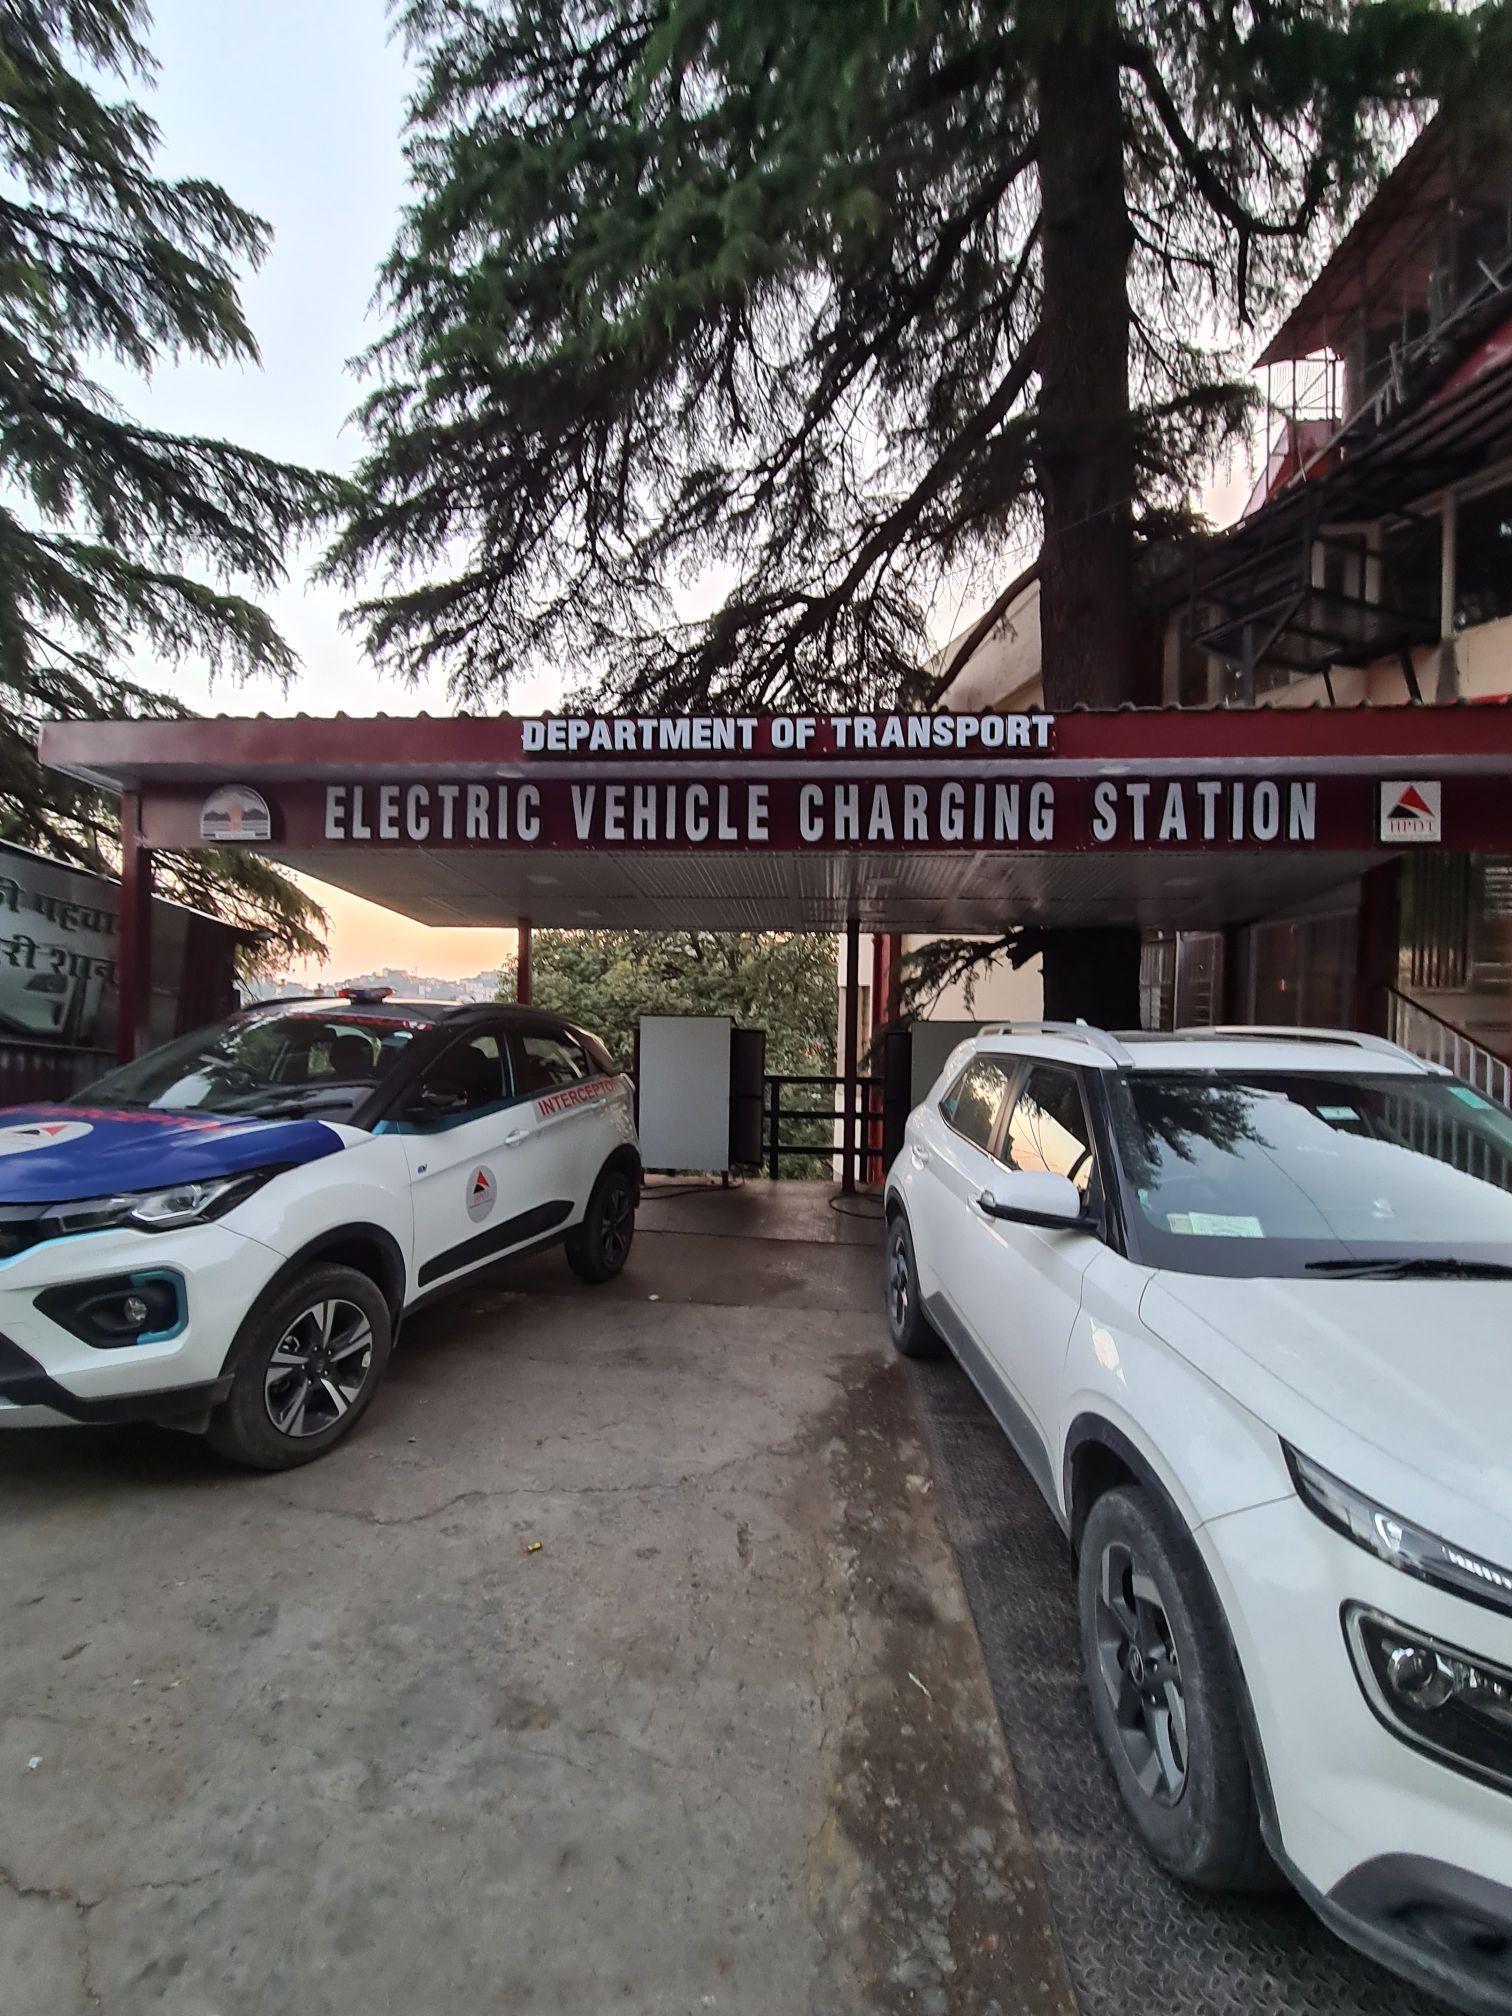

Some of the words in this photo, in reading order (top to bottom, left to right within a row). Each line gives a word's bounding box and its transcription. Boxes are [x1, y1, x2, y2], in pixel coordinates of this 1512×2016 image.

[521, 717, 758, 751] DEPARTMENT
[770, 716, 815, 749] OF
[831, 714, 1055, 748] TRANSPORT
[325, 784, 540, 841] ELECTRIC
[571, 784, 769, 841] VEHICLE
[800, 782, 1054, 842] CHARGING
[1093, 781, 1316, 842] STATION
[32, 892, 118, 936] पहचा
